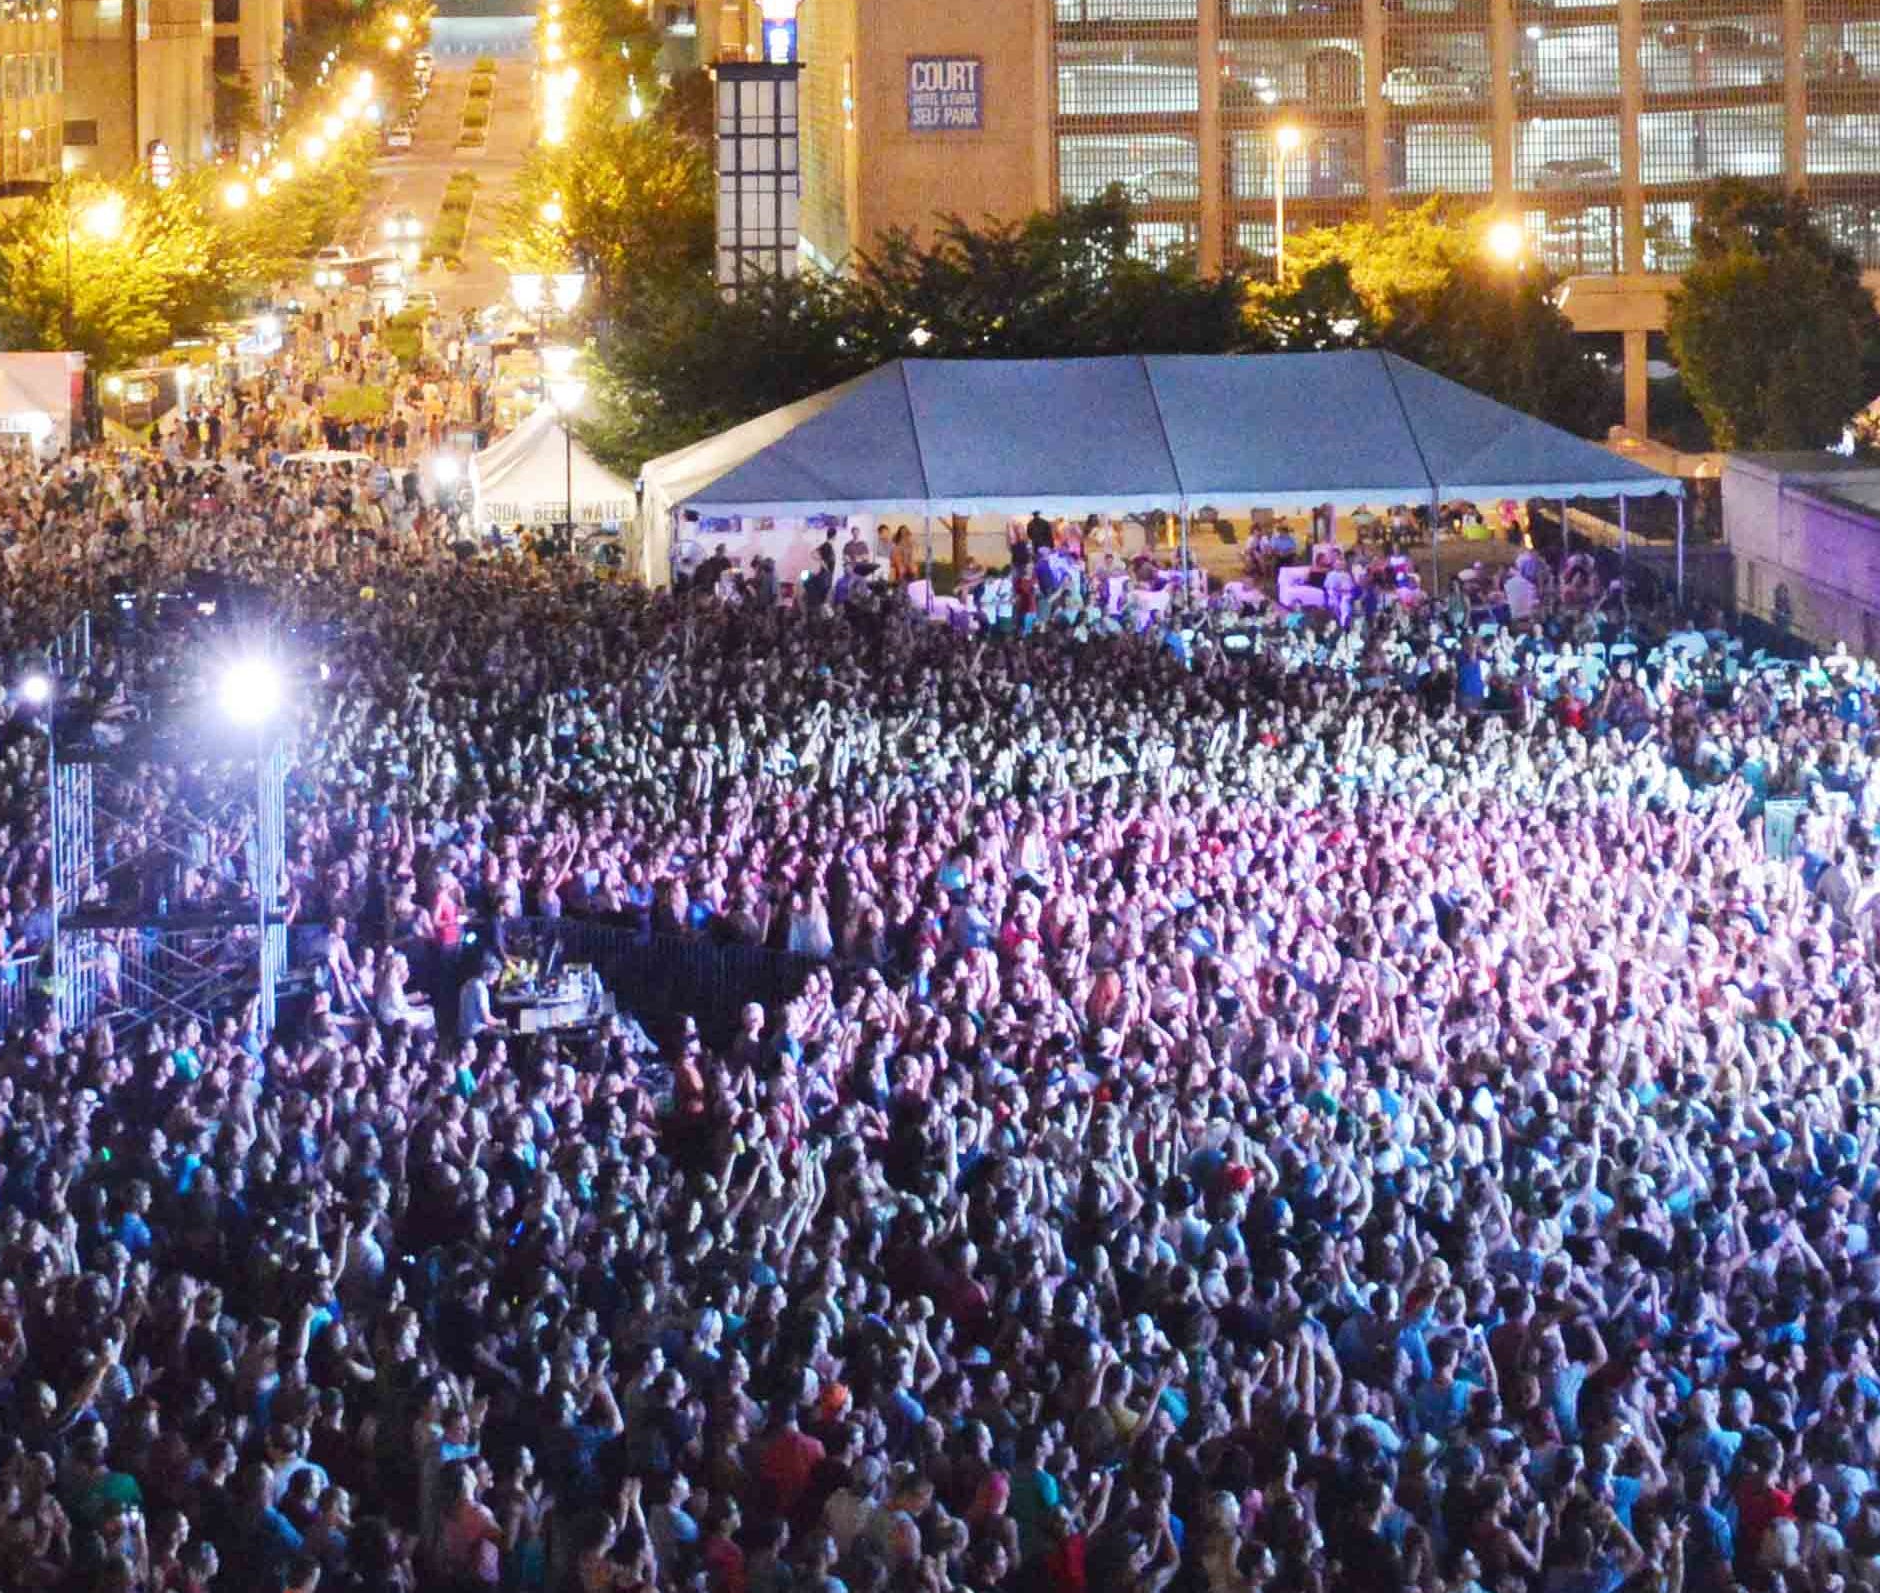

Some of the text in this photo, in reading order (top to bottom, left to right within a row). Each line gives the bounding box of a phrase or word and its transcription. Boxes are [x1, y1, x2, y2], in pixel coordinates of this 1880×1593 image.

[911, 61, 979, 91] COURT
[913, 107, 977, 125] SELF PARK
[487, 502, 520, 522] SODA
[534, 504, 568, 522] BEER
